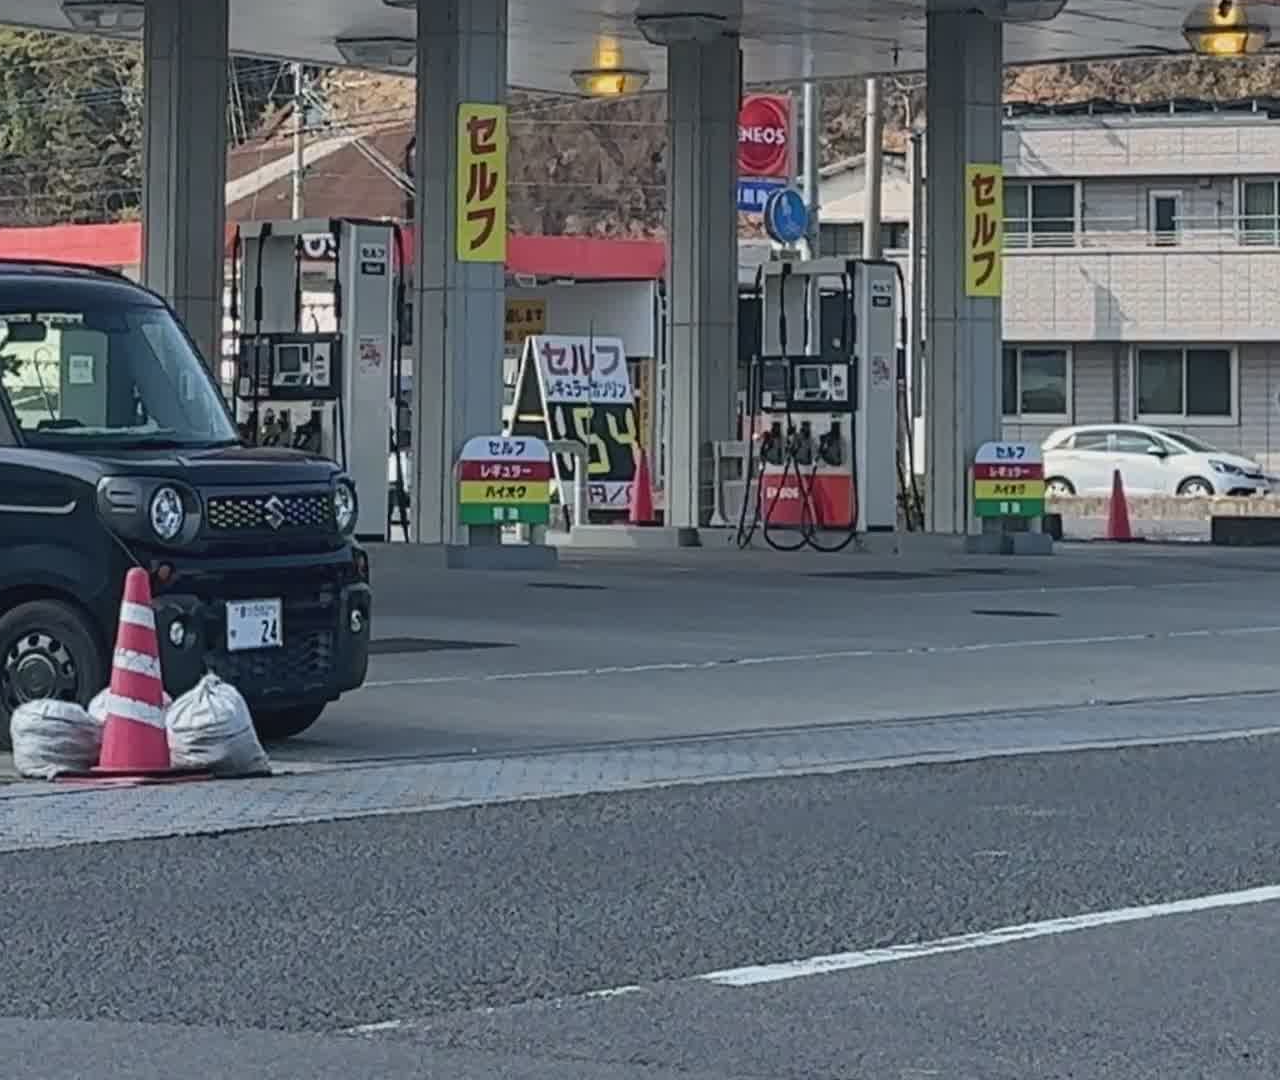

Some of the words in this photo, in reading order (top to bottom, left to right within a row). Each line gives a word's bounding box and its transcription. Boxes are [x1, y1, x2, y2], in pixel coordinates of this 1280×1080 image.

[466, 114, 497, 251] セルフ
[971, 172, 995, 287] セルフ
[540, 341, 620, 378] セルフ
[488, 441, 527, 457] セルフ
